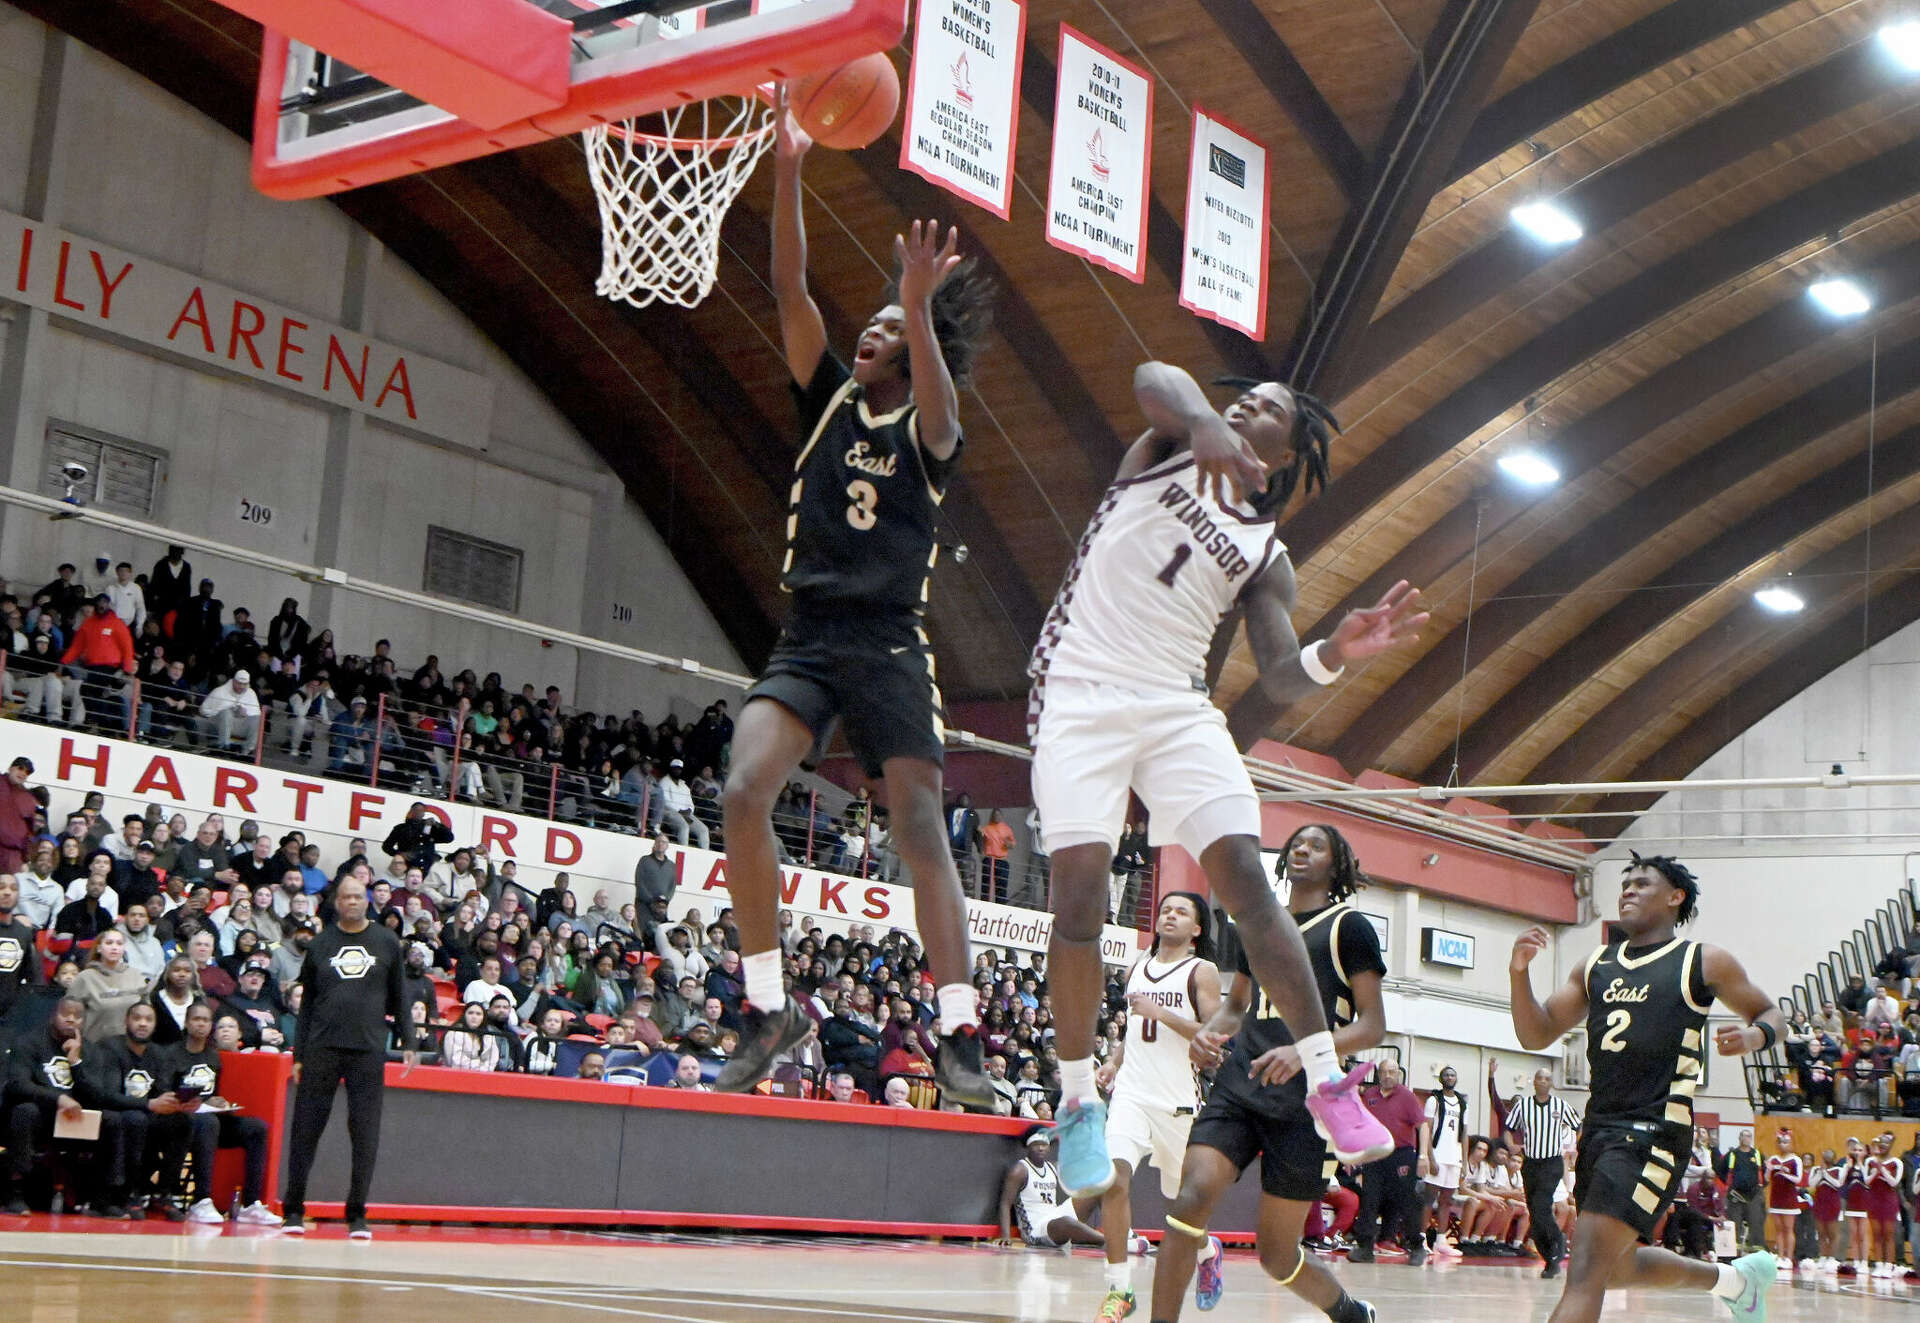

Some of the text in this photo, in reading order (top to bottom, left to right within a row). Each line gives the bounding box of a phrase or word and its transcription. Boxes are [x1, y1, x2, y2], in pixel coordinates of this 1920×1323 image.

[952, 1, 991, 34] WOMEN'S
[942, 16, 996, 59] BASKETBALL
[1092, 63, 1120, 89] 2010-11
[1078, 94, 1127, 132] BASKETBALL
[1088, 80, 1123, 110] WOMEN'S
[930, 110, 993, 151] REGULAR SEASON
[936, 99, 989, 136] AMERICA EAST
[942, 130, 980, 157] CHAMPION
[917, 136, 1000, 190] NCAA TOURNAMENT
[1071, 177, 1103, 202] AMERICA
[1078, 196, 1116, 222] CHAMPION
[1054, 211, 1134, 256] NCAA TOURNAMENT
[167, 287, 417, 419] ARENA
[844, 441, 897, 477] East
[241, 502, 271, 524] 209
[846, 479, 878, 531] 3
[1158, 482, 1249, 582] WINDSOR
[1156, 542, 1192, 588] 1
[1438, 938, 1468, 960] NCAA
[1602, 977, 1650, 1003] East
[1600, 1009, 1631, 1052] 2
[1448, 1119, 1455, 1131] 4
